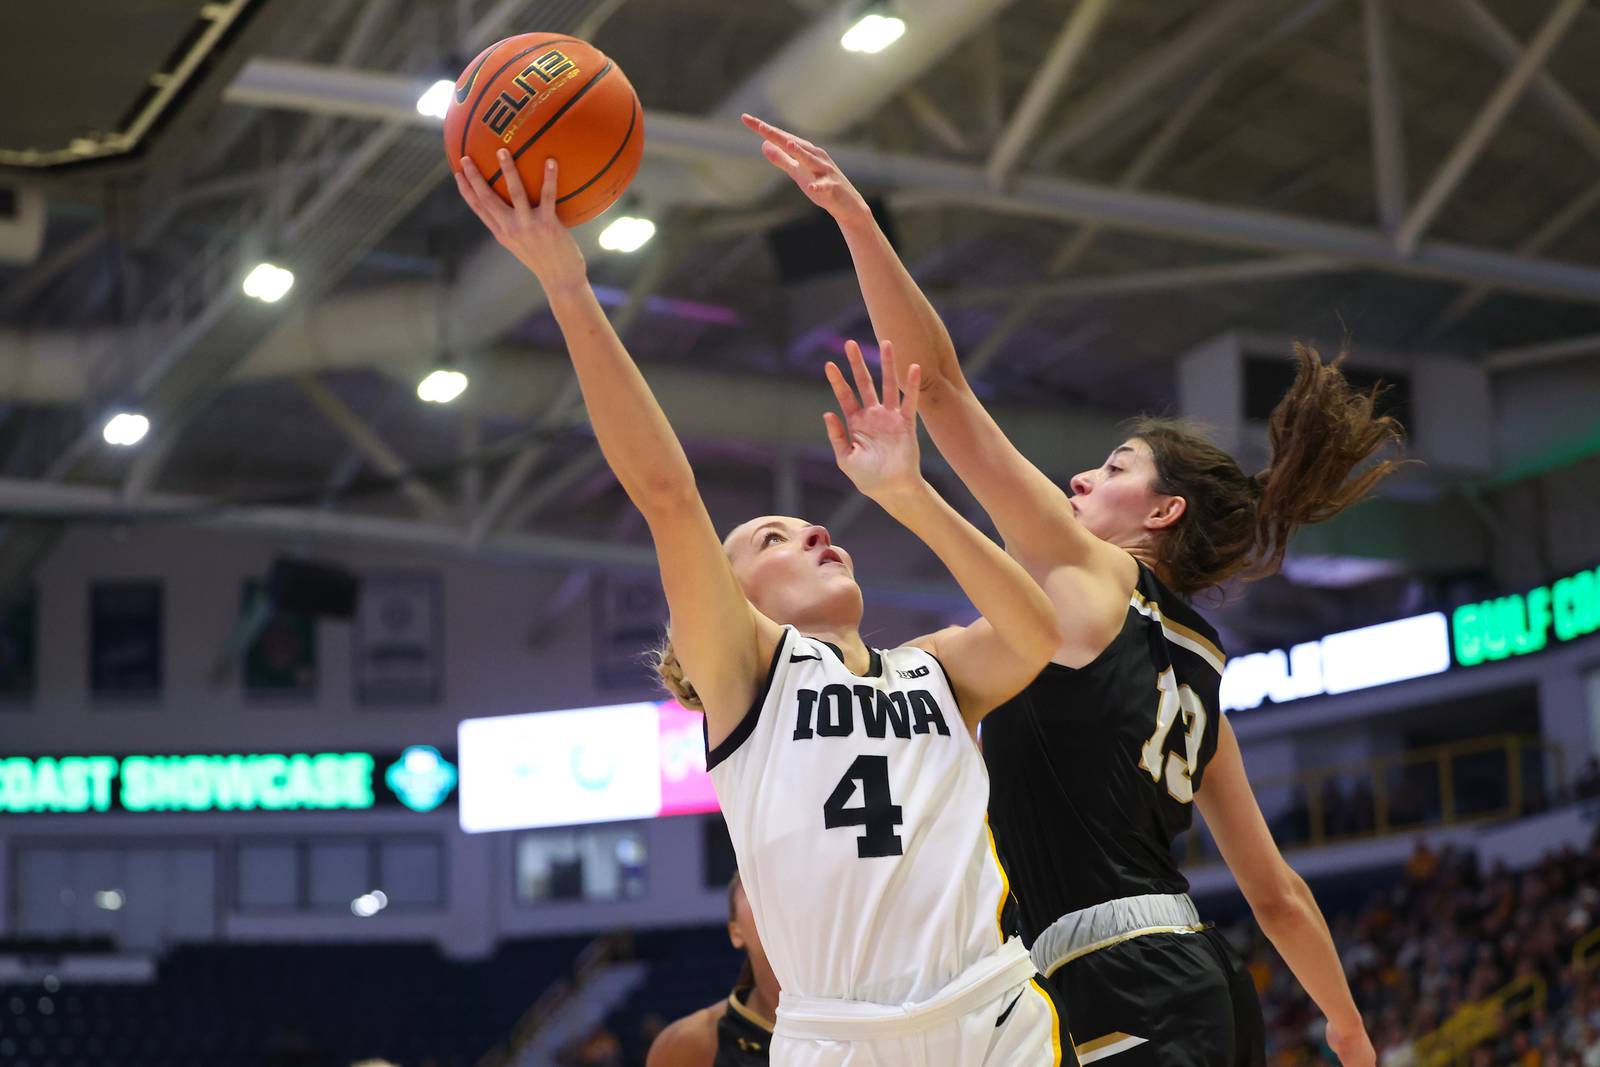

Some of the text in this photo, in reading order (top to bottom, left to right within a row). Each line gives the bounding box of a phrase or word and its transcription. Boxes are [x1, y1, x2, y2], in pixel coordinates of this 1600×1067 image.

[481, 48, 576, 138] ELITE
[1452, 563, 1600, 667] GULF CO
[792, 683, 951, 741] IOWA
[1138, 663, 1208, 804] 13
[0, 753, 375, 813] OAST SHOWCASE
[824, 754, 903, 859] 4
